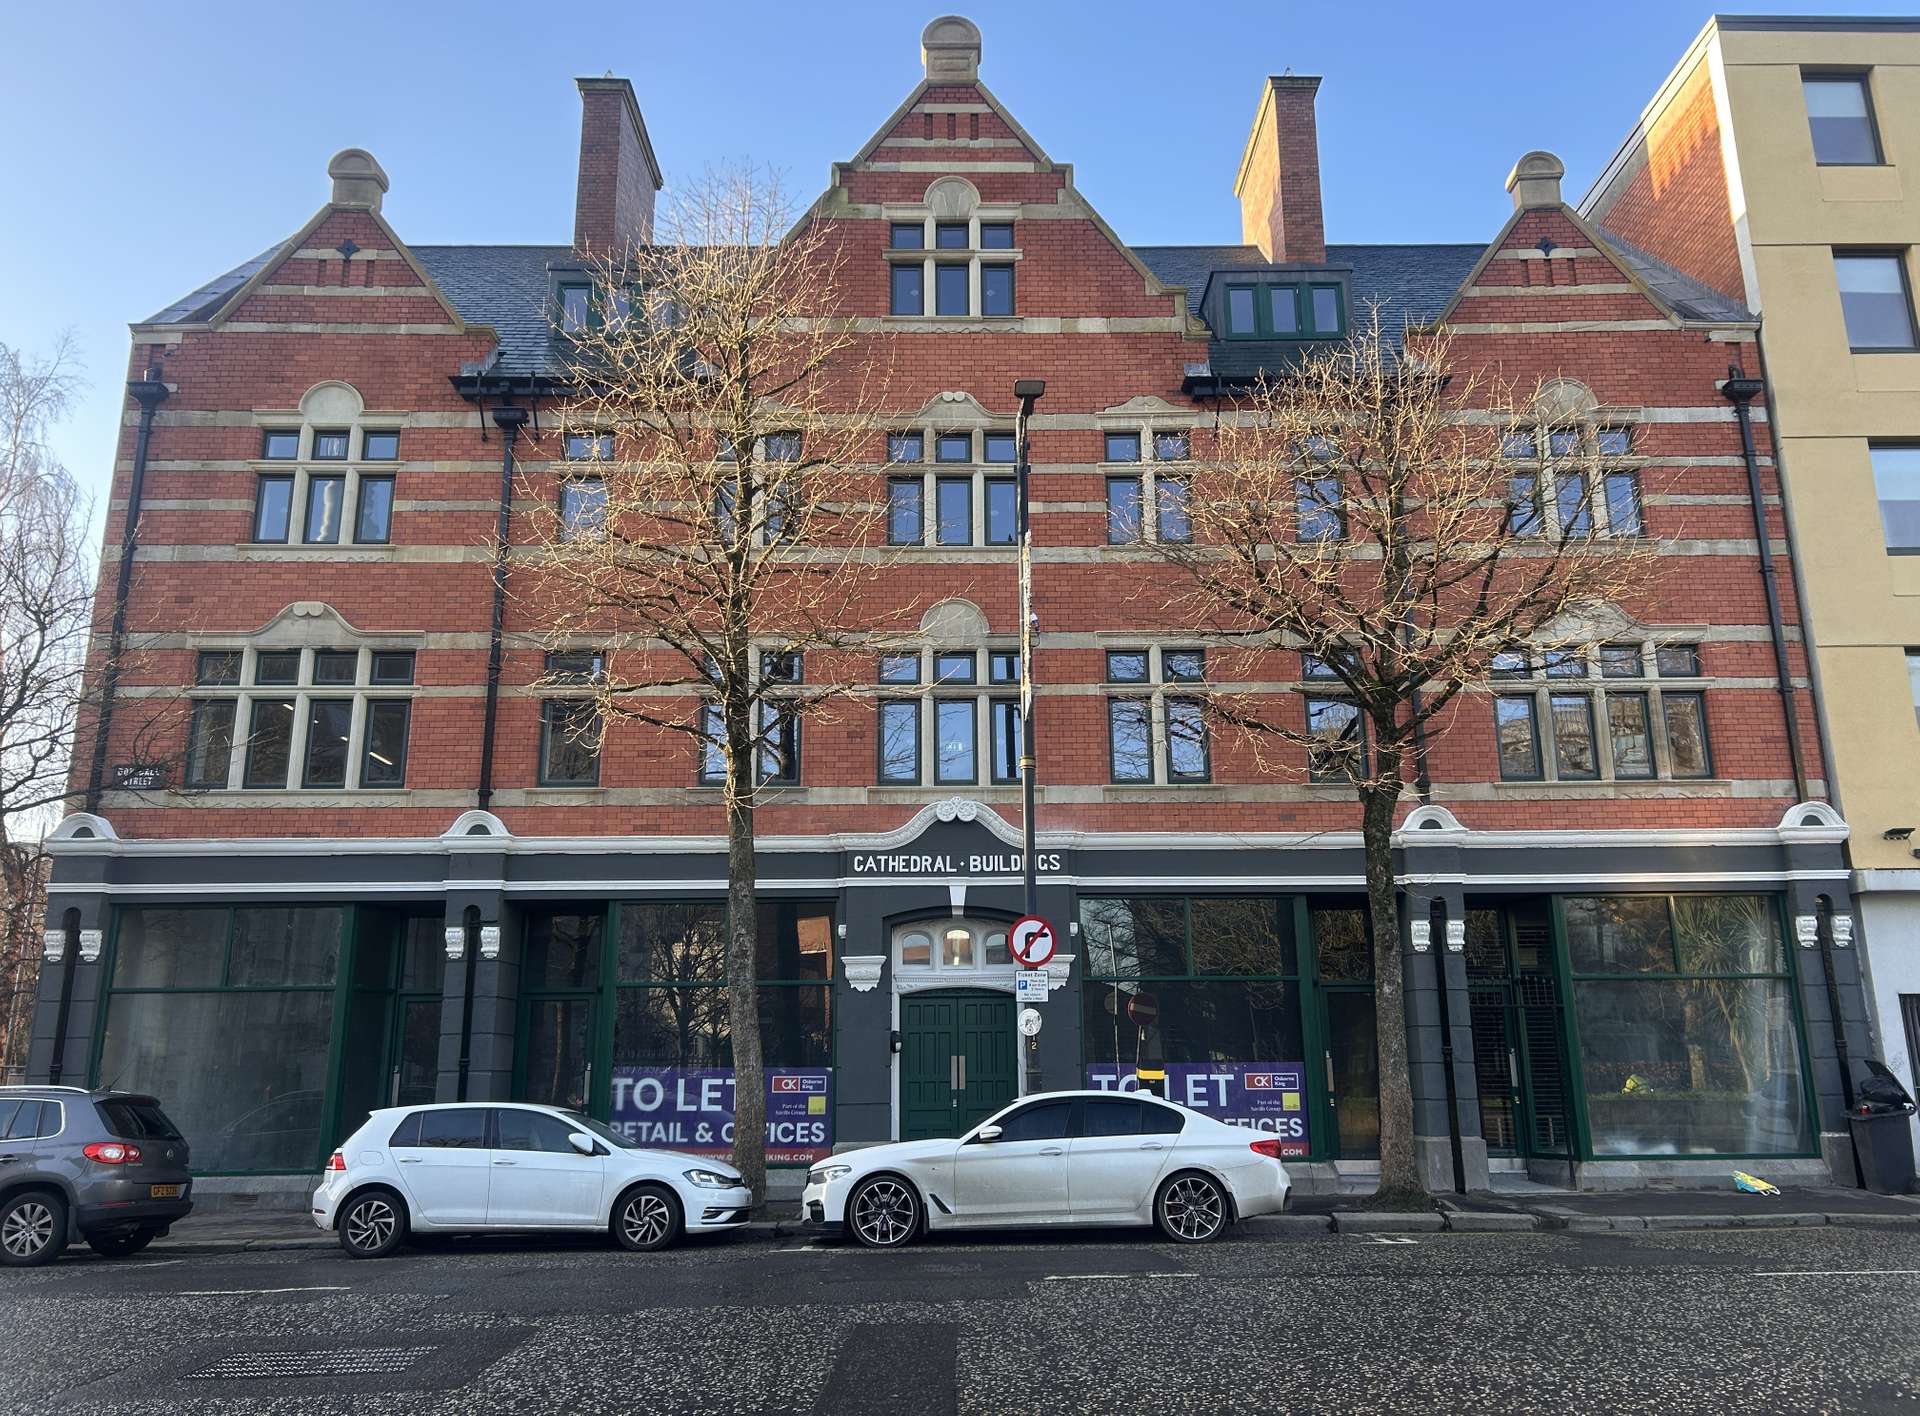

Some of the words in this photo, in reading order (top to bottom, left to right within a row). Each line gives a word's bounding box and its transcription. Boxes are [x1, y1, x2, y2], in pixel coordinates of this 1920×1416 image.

[853, 855, 957, 873] CATHEDRAL
[969, 854, 1061, 872] BUILDIGS
[611, 1077, 664, 1112] TO
[1164, 1074, 1235, 1107] LET
[695, 1122, 714, 1143] &
